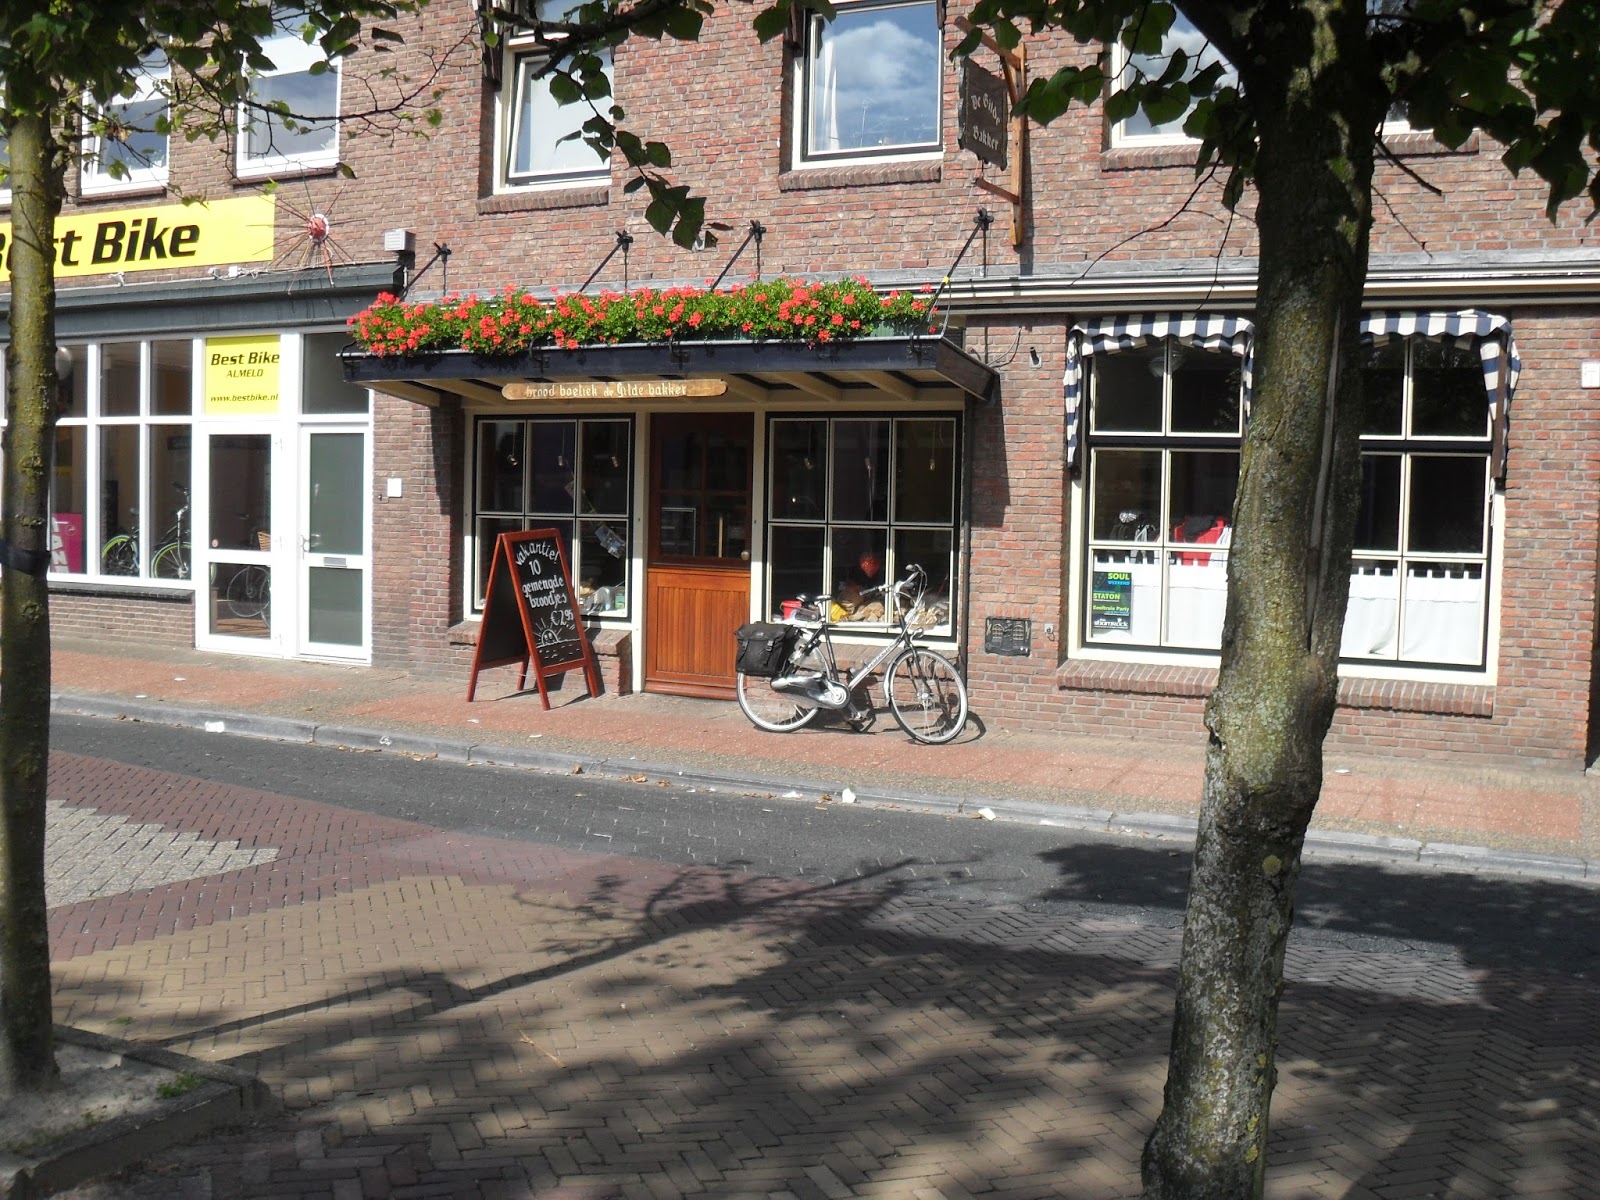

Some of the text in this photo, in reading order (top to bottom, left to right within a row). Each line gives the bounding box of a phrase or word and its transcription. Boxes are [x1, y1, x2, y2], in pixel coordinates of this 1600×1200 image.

[971, 93, 1000, 125] De Gilde
[973, 125, 998, 150] Bakker
[91, 217, 200, 265] Bike
[210, 351, 280, 366] Best Bike
[226, 368, 264, 378] ALMELO
[210, 393, 279, 402] www.bestbike.nl
[526, 384, 555, 398] brood
[603, 387, 614, 397] de
[616, 382, 644, 398] Gilde
[648, 382, 687, 396] bakker
[516, 541, 559, 565] vakantie!
[528, 559, 542, 576] 10
[522, 575, 564, 598] gemengde
[529, 591, 567, 609] broodjes
